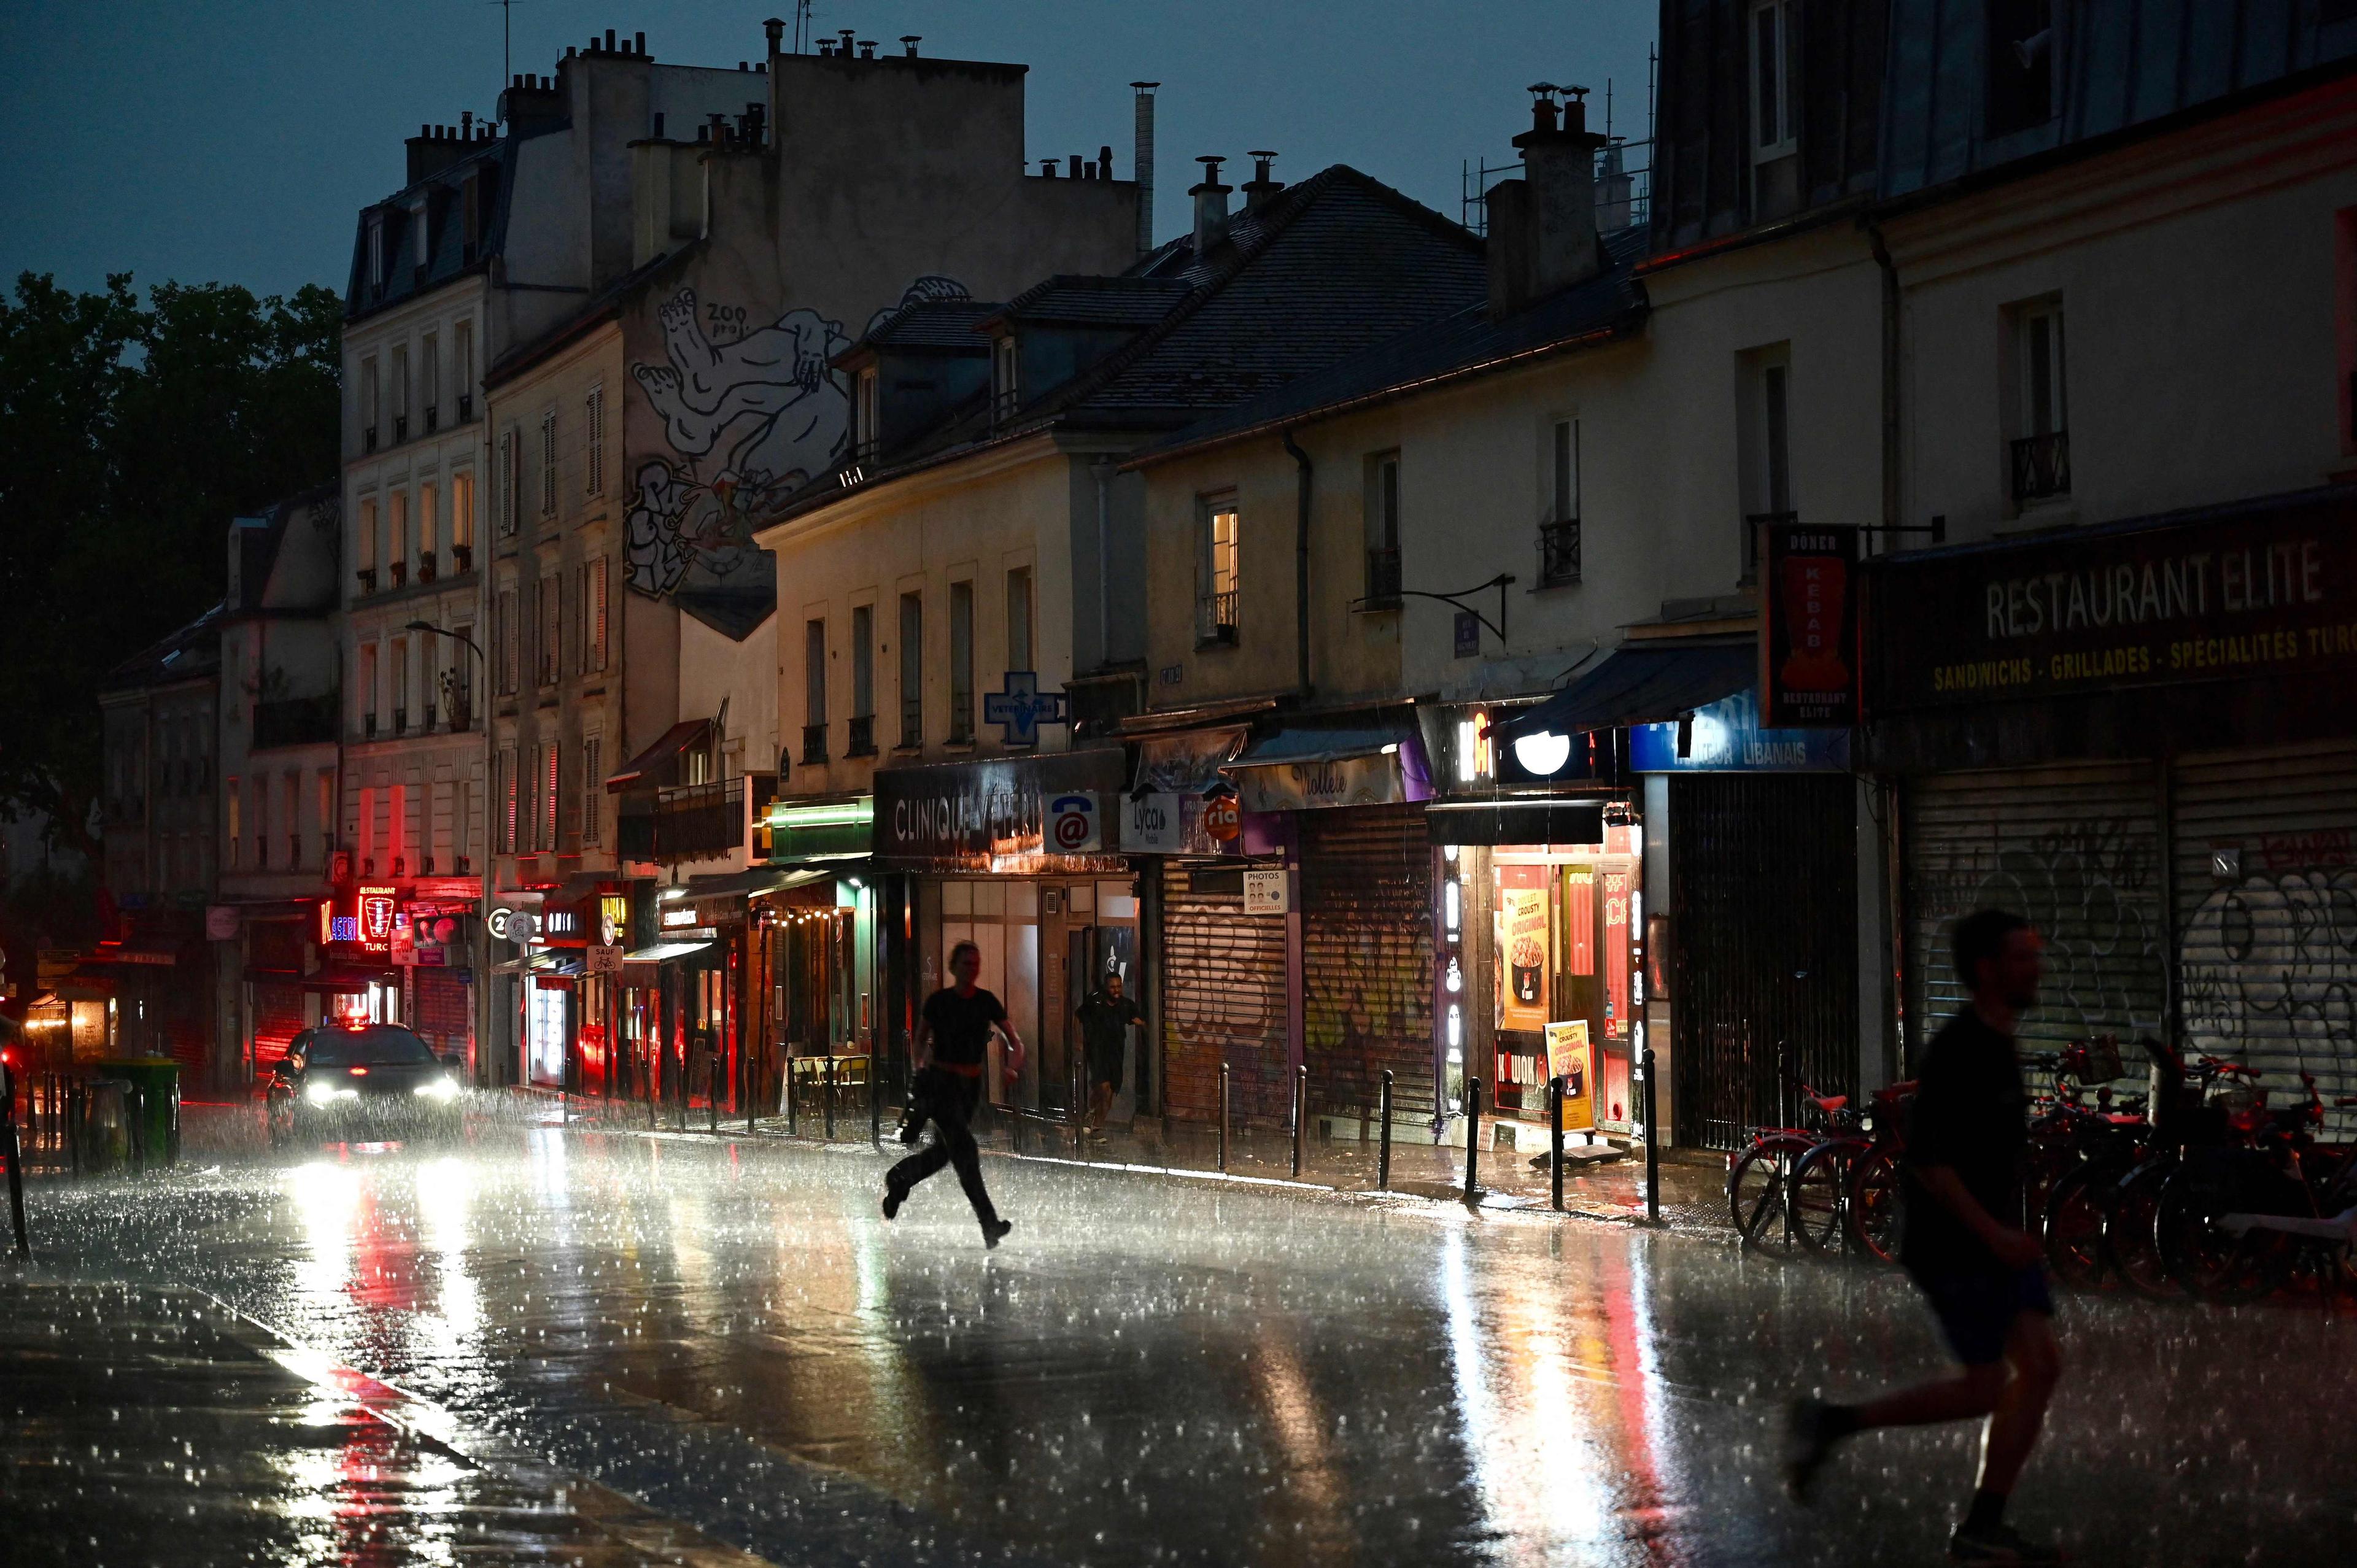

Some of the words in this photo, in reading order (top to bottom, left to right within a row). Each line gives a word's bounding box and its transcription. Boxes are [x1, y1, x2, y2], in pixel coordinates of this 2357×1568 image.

[1986, 552, 2212, 640] RESTAURANT
[2221, 538, 2323, 613] ELITE
[1806, 566, 1822, 648] KEBAB
[1933, 657, 2032, 692] SANDWICHS
[2051, 644, 2150, 681] GRILLADES
[2170, 625, 2298, 668] SPÉCIALITÉS
[1782, 692, 1847, 705] RESTAURANT
[1743, 741, 1806, 765] LIBANAIS
[895, 797, 971, 841] CLINIQUE
[1135, 800, 1158, 835] Lyca
[1208, 804, 1238, 825] ria
[1145, 834, 1158, 844] Mobile
[1518, 902, 1540, 916] CROUSTY
[1512, 915, 1546, 937] ORIGINAL
[365, 943, 388, 951] TURC
[1555, 1039, 1584, 1056] ORIGINAL
[1559, 1032, 1577, 1043] CROUSTY
[1498, 1051, 1535, 1085] KAWOK
